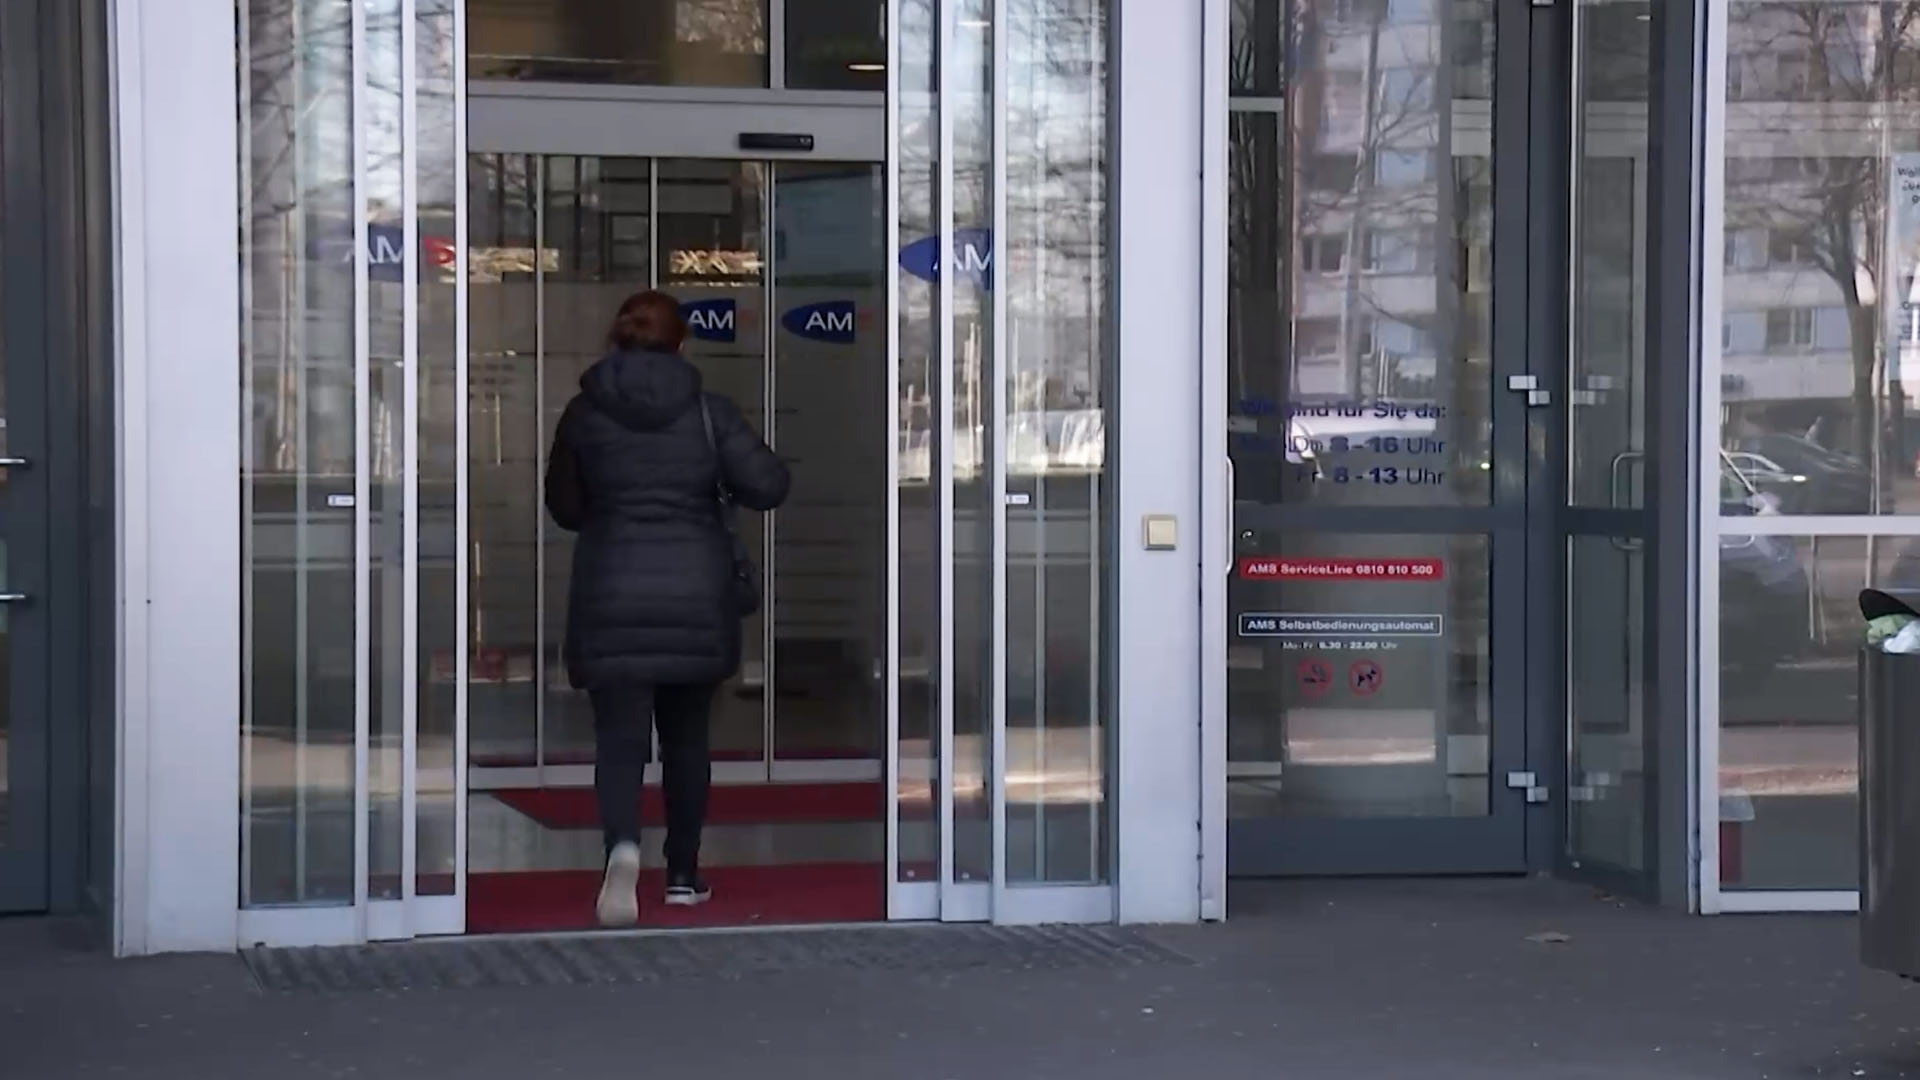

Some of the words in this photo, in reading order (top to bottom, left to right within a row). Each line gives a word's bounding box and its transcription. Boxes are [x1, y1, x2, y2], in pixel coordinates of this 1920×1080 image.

[1373, 402, 1407, 418] Sie
[1415, 402, 1446, 418] da:
[1367, 436, 1398, 453] 16
[1407, 437, 1445, 453] Uhr
[1334, 467, 1349, 484] 8
[1369, 467, 1398, 484] 13
[1406, 467, 1444, 484] Uhr
[1247, 563, 1277, 575] AMS
[1280, 563, 1353, 575] ServiceLine
[1356, 564, 1385, 575] 0810
[1387, 564, 1409, 575] 810
[1411, 564, 1433, 575] 500
[1247, 620, 1276, 630] AMS
[1279, 620, 1434, 632] Selbstbedienungsautomat
